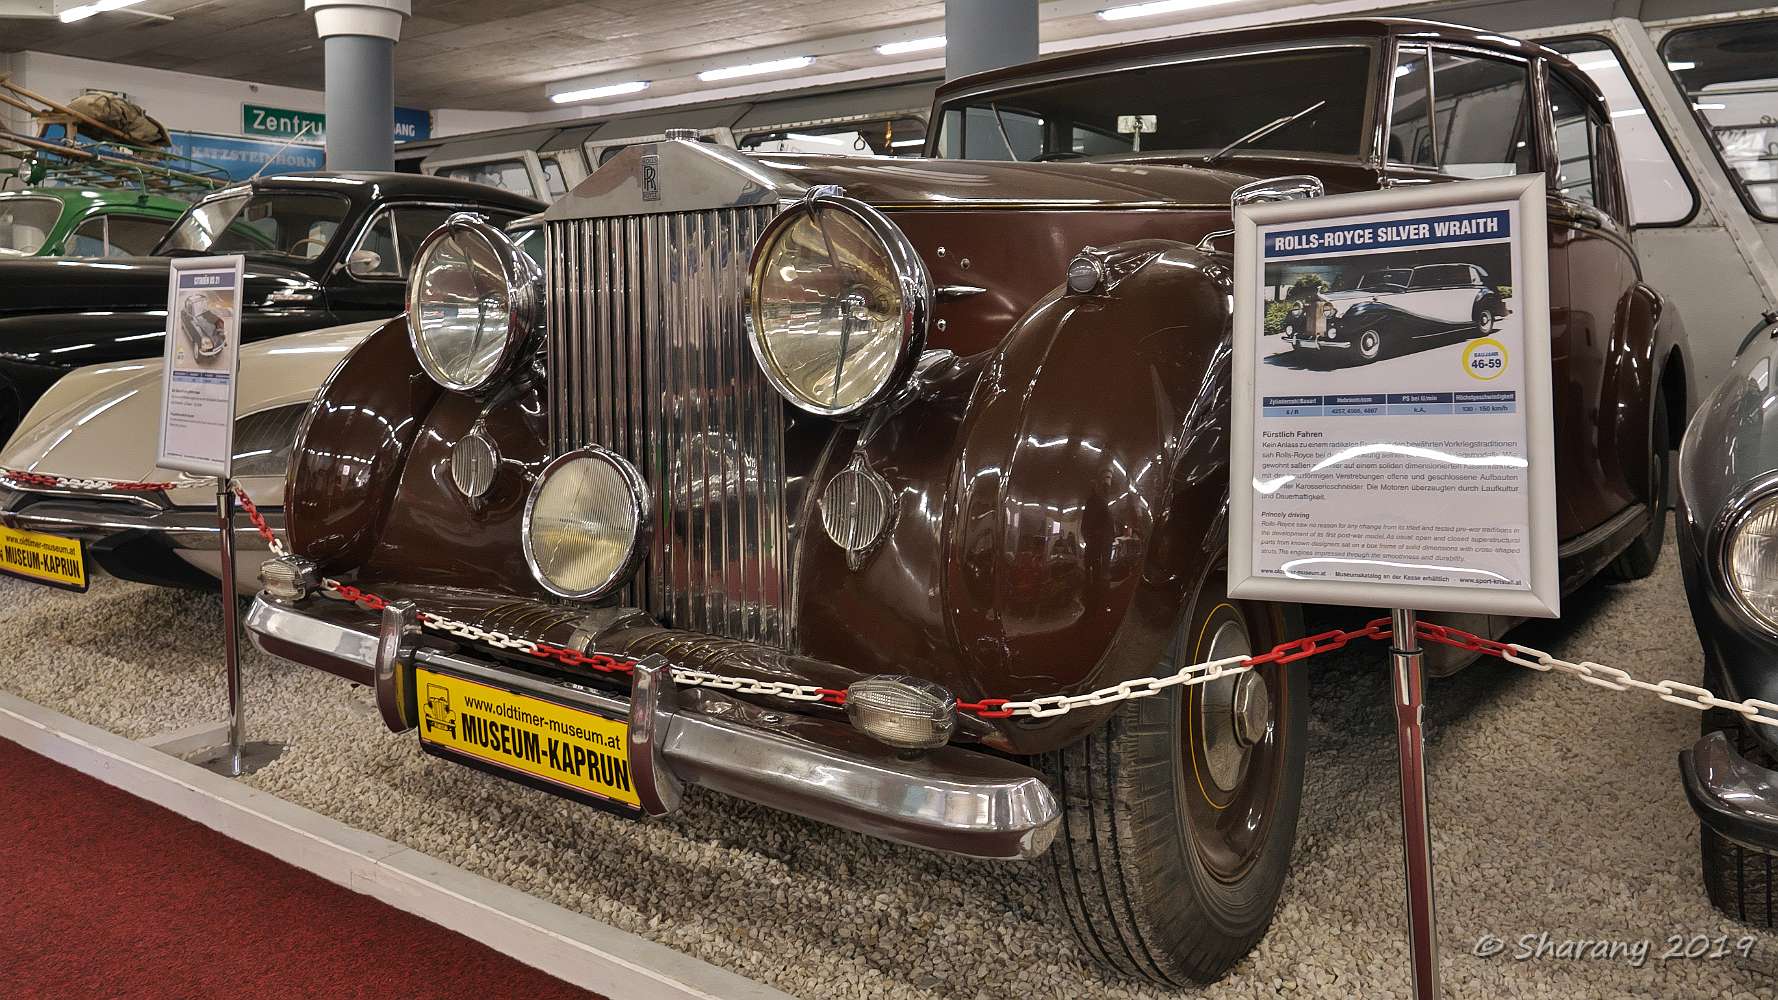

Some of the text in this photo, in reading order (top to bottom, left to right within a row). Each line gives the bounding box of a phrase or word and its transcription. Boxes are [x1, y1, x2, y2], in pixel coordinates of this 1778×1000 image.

[253, 110, 323, 136] Zentru
[394, 124, 415, 137] ANG
[1274, 217, 1498, 251] ROLLS-ROYCE SILVER WRAITH
[1471, 359, 1502, 369] 46-59
[1262, 430, 1323, 438] Fürstlich Fahren
[1287, 511, 1310, 519] driving
[6, 535, 76, 556] www.oldtimer-museum.at
[5, 545, 80, 579] MUSEUM-KAPRUN
[464, 695, 621, 751] www.oldtimer-museum.at
[461, 712, 631, 792] MUSEUM-KAPRUN
